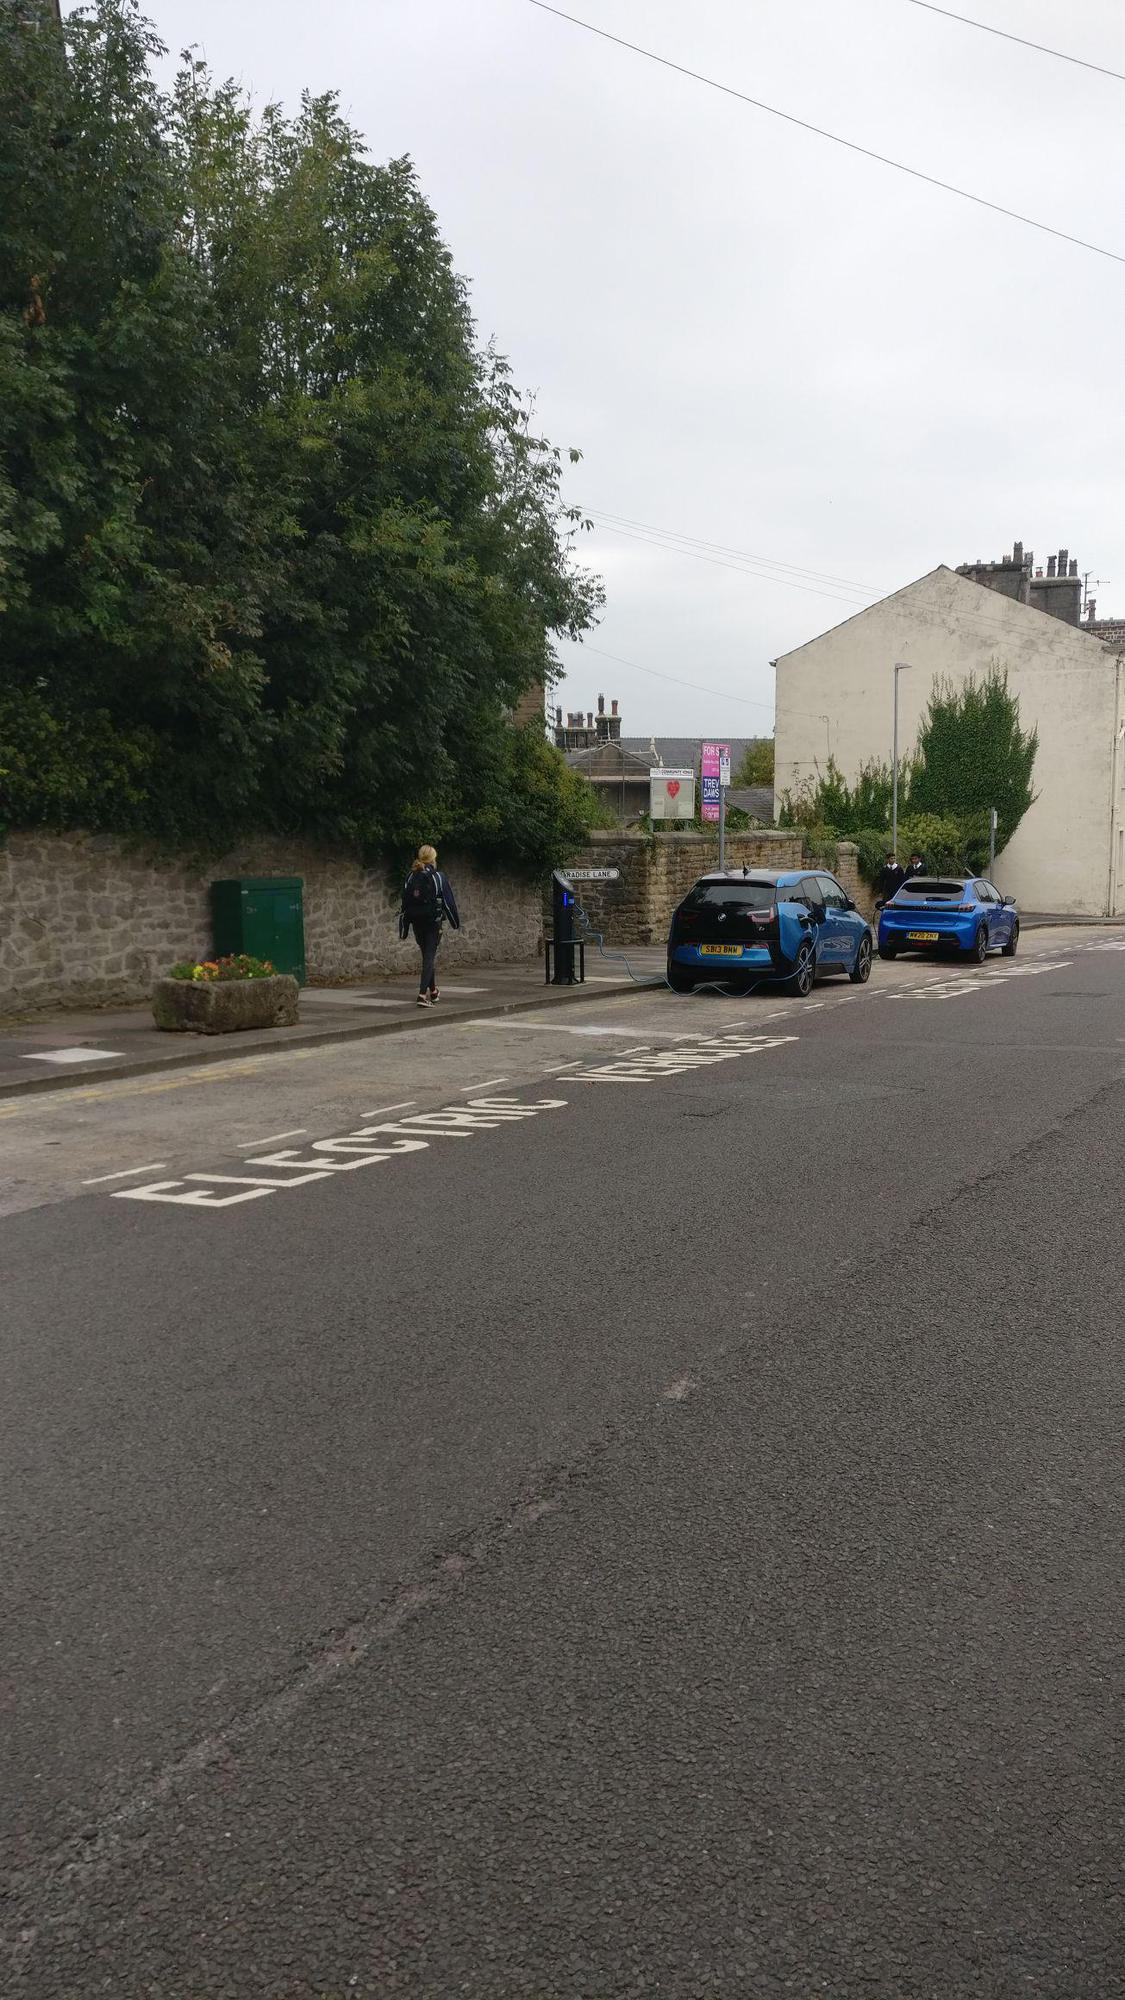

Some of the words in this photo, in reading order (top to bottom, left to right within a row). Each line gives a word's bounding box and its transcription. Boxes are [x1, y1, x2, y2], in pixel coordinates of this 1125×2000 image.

[704, 746, 715, 756] FOR
[110, 1097, 569, 1208] ELECTRIC
[555, 1034, 800, 1082] VEHICLES
